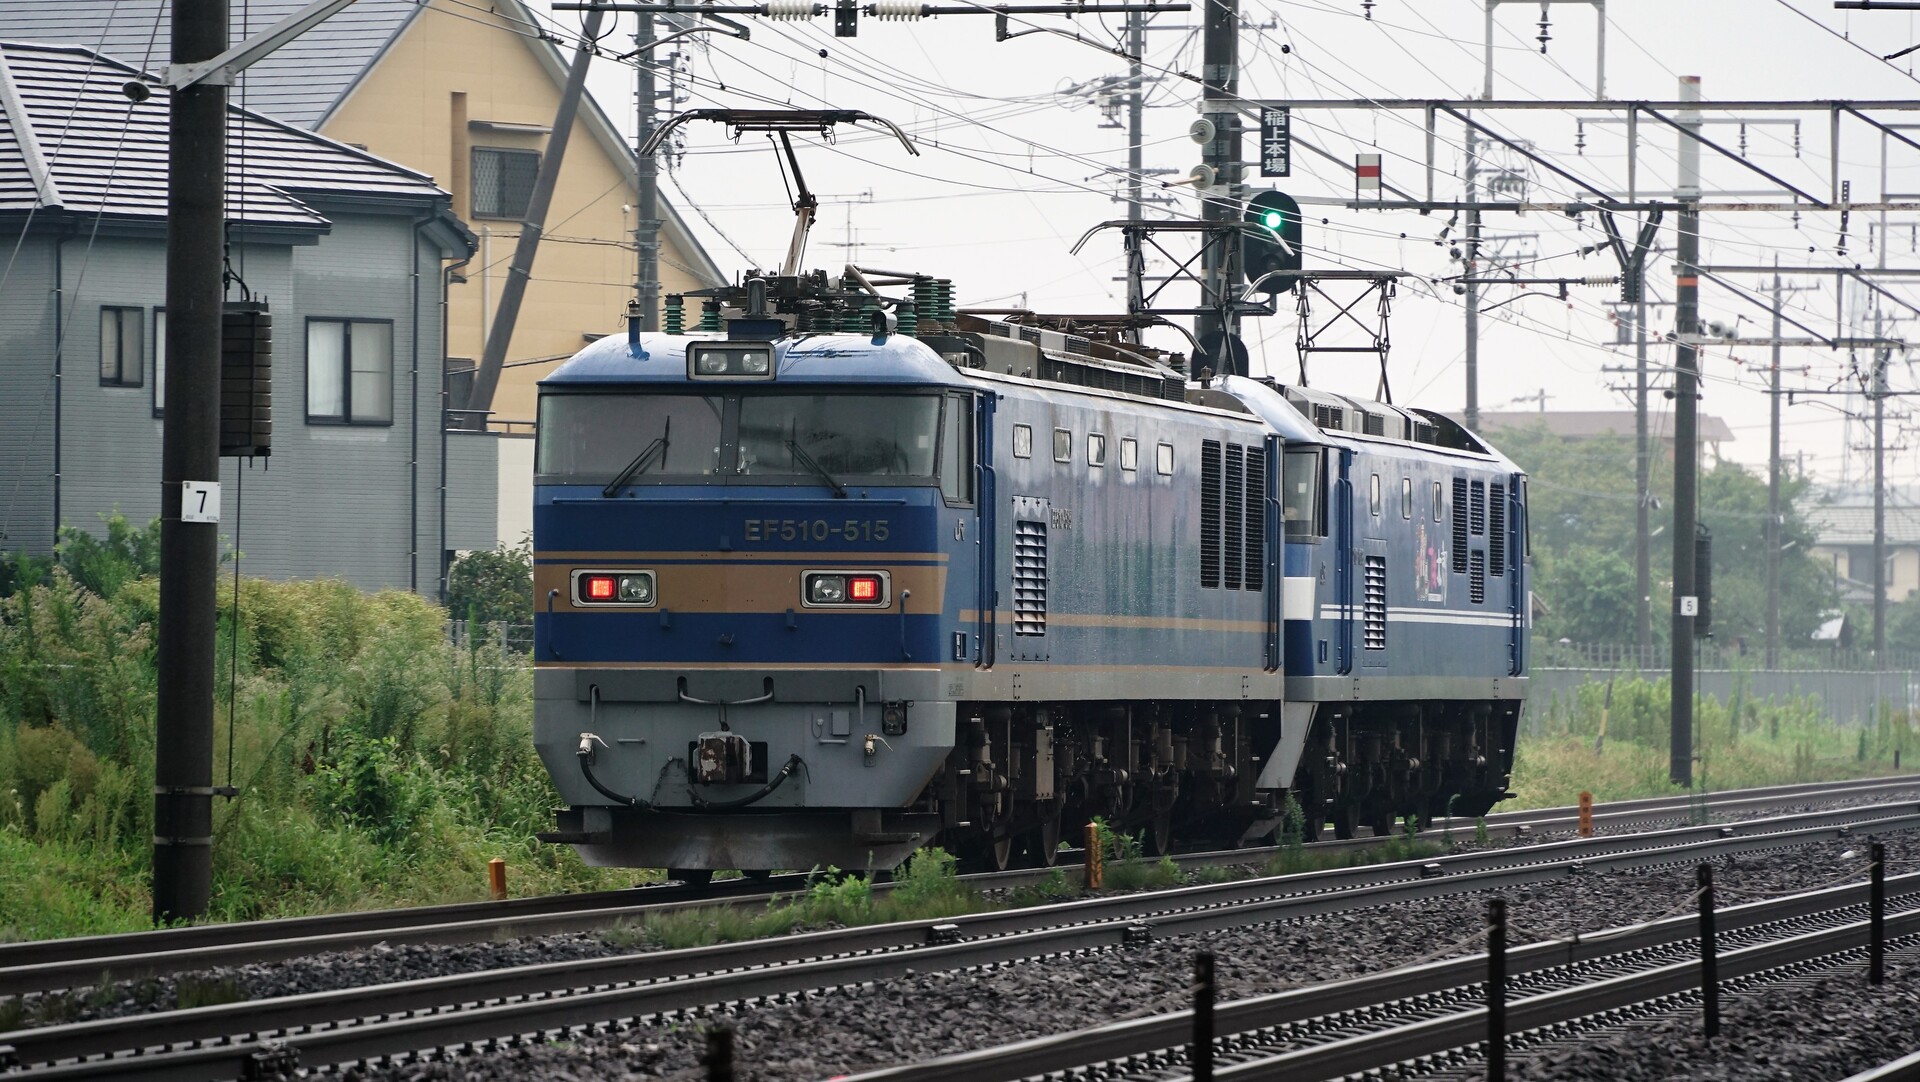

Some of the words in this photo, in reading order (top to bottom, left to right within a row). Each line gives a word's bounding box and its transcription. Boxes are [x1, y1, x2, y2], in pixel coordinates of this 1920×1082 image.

[1264, 110, 1286, 173] 稲上本場
[195, 490, 207, 513] 7
[744, 519, 889, 541] EF510-515
[953, 518, 965, 541] JR
[1686, 600, 1693, 612] 5
